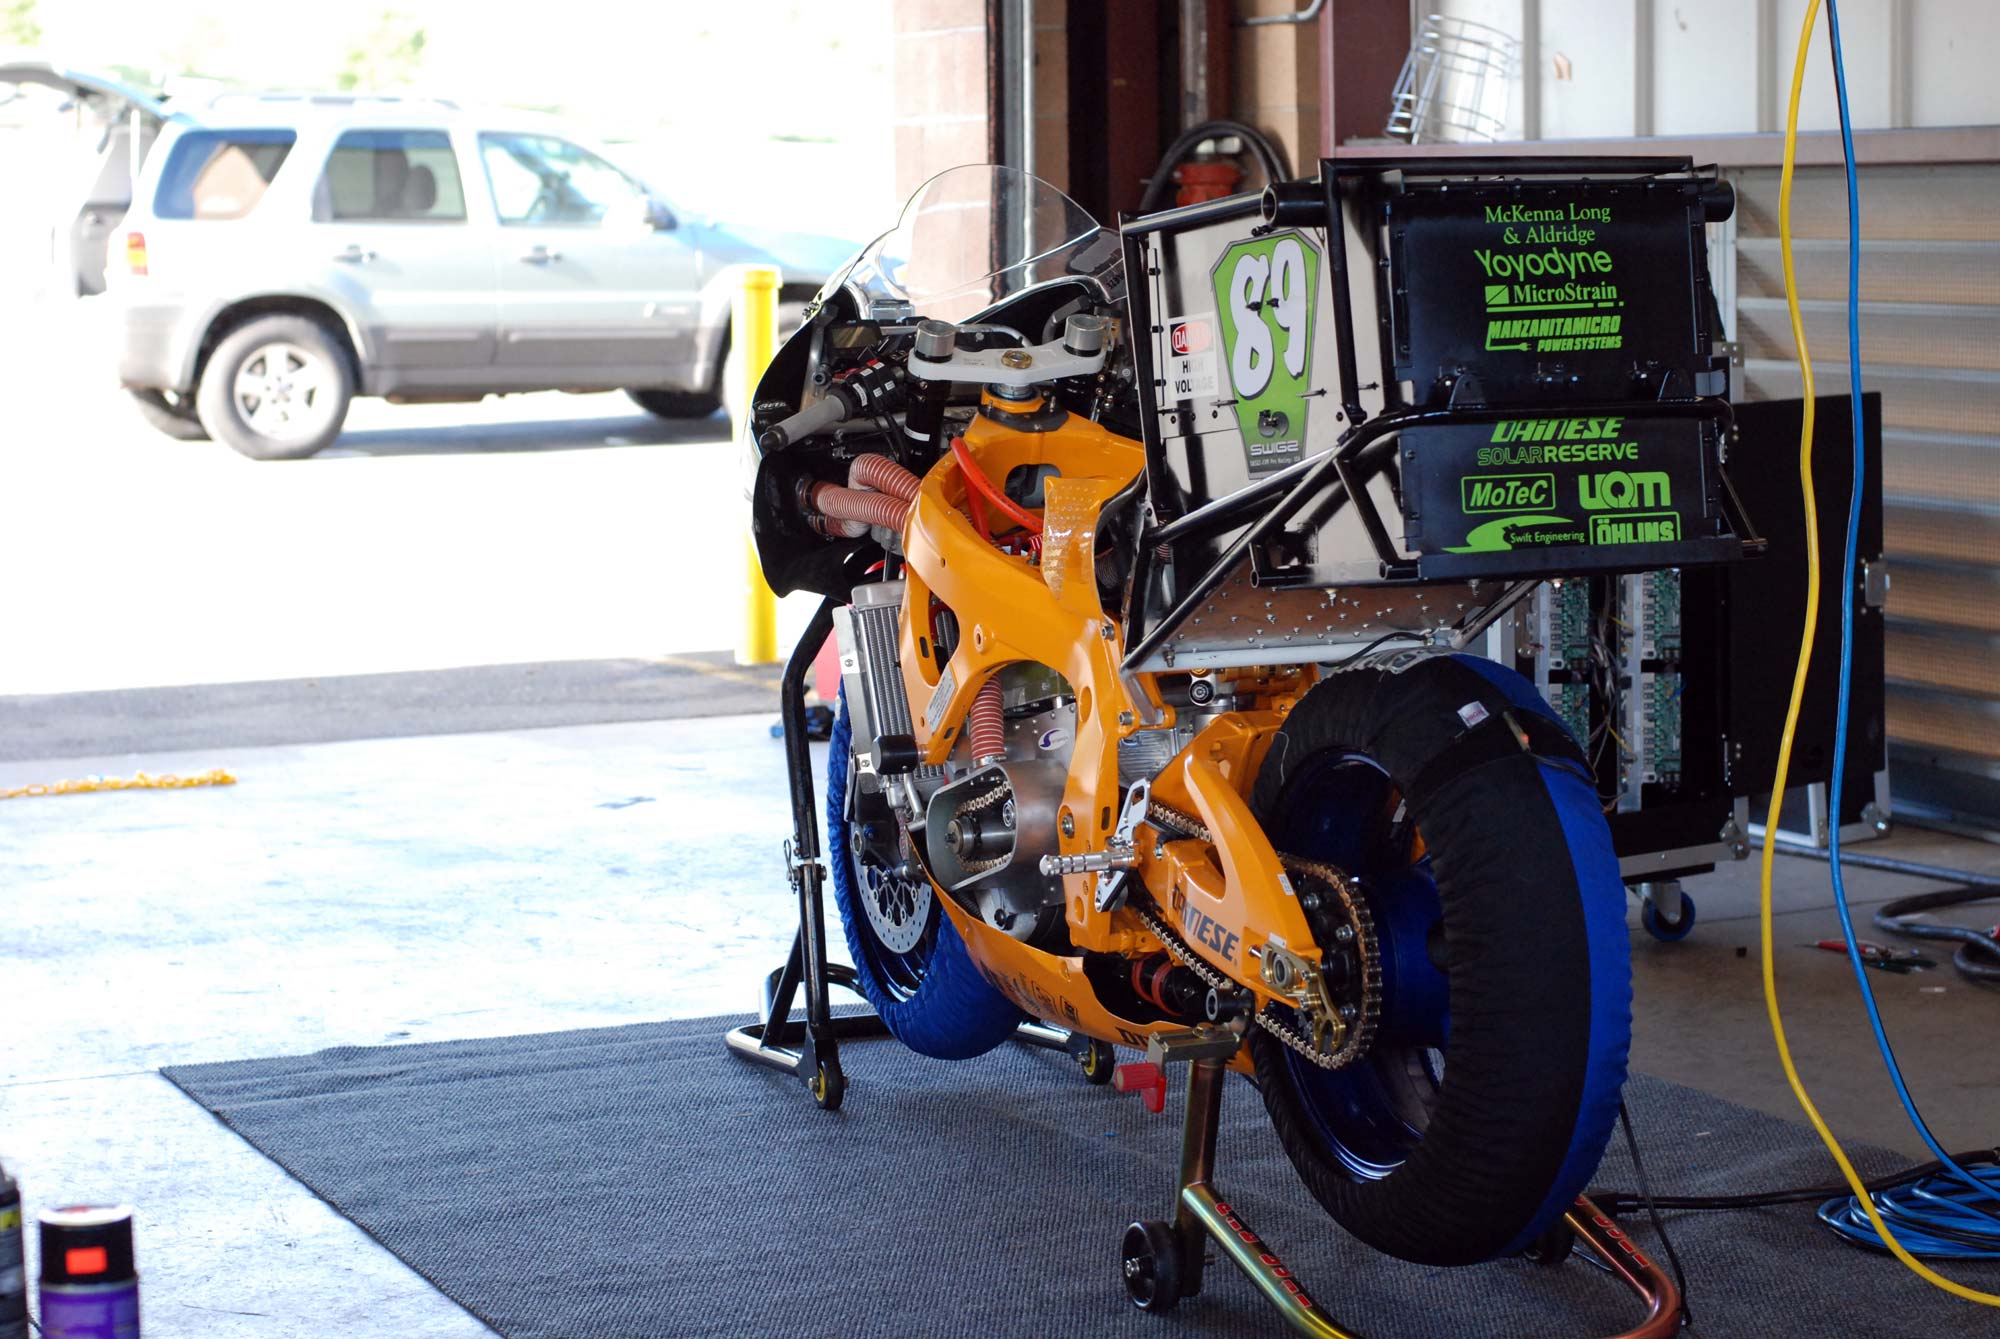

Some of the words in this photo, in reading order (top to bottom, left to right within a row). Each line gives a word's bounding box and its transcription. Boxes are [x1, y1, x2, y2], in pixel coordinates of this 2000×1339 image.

[1485, 204, 1564, 224] McKenna
[1569, 203, 1611, 223] Long
[1503, 226, 1521, 244] &
[1525, 224, 1596, 246] Aldridge
[1474, 246, 1613, 282] Yoyodyne
[1514, 281, 1617, 303] MicroStrain
[1230, 238, 1307, 400] 89
[1470, 479, 1548, 507] MoTeC
[1509, 531, 1532, 544] Swift
[1535, 531, 1585, 545] Engineering
[1597, 518, 1674, 544] ÖHLINS
